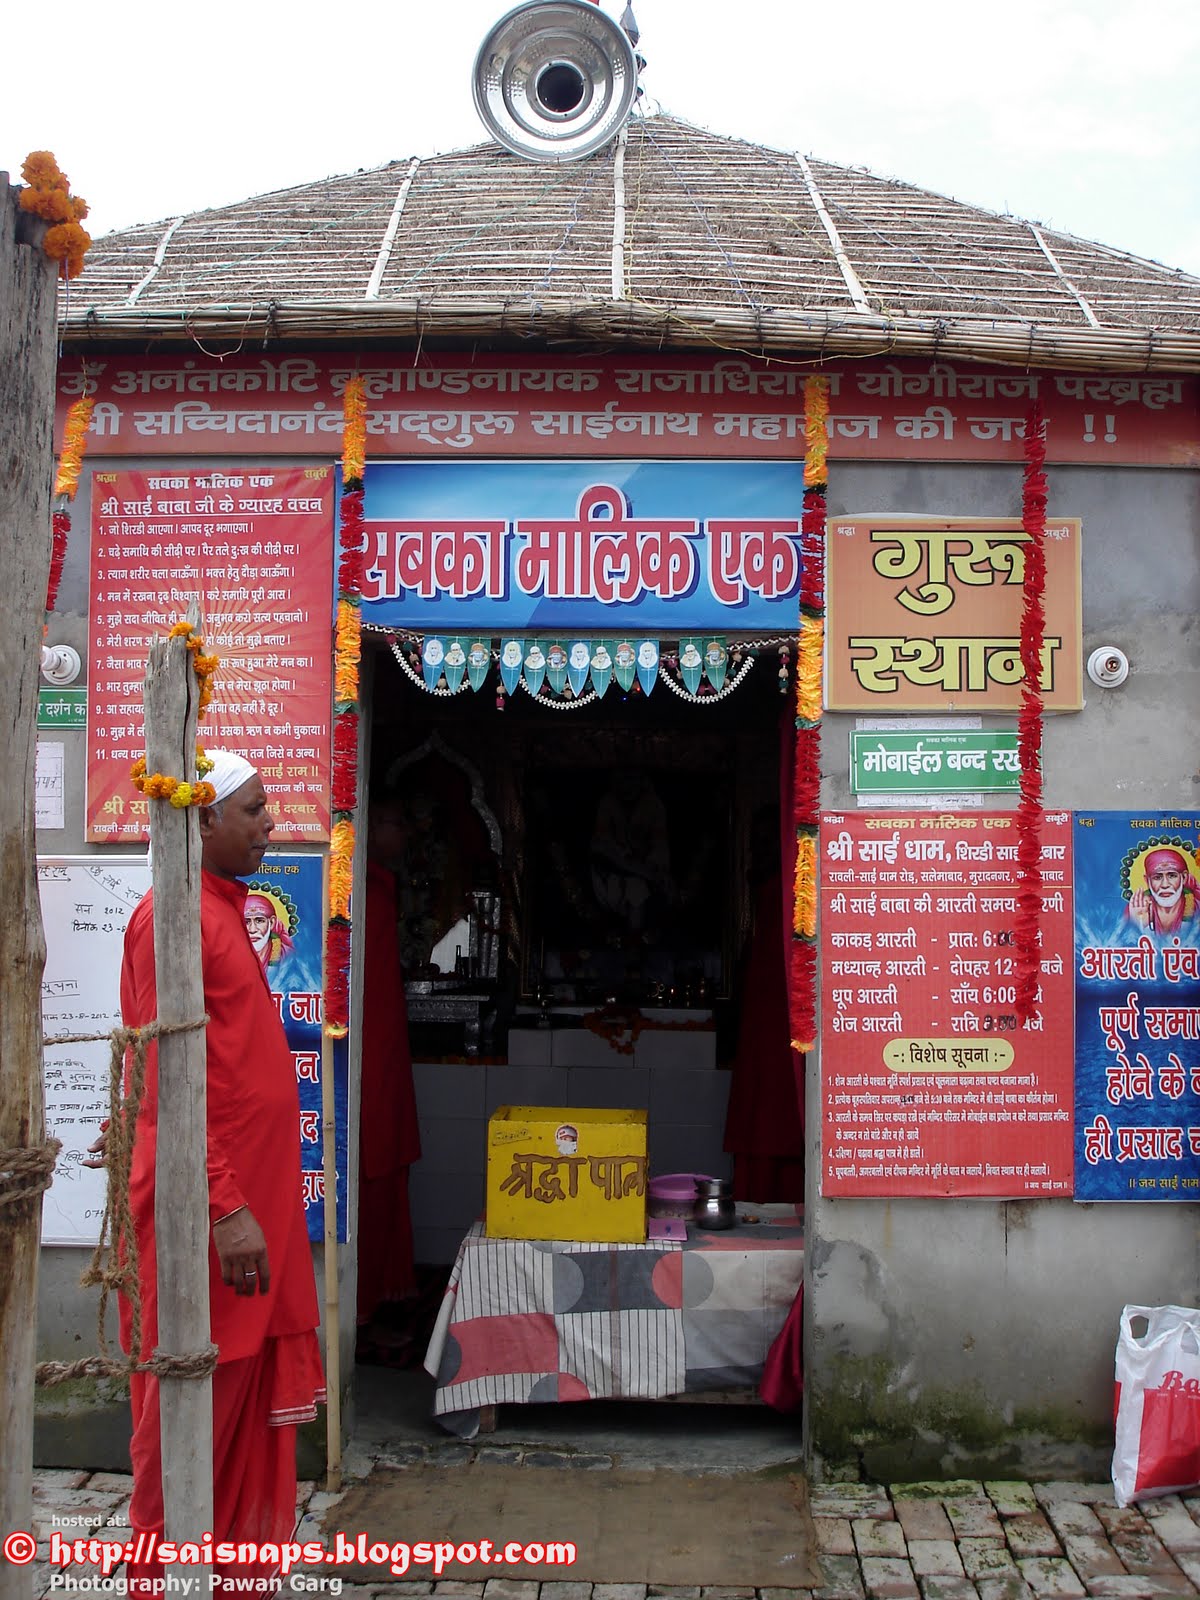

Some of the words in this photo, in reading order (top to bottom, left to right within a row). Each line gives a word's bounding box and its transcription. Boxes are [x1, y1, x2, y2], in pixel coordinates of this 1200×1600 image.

[111, 359, 321, 393] अनंतकोटि
[856, 364, 1040, 399] योगीराज
[894, 406, 957, 441] की
[148, 478, 190, 489] सबका
[248, 476, 274, 487] एक
[101, 497, 118, 514] श्री
[157, 501, 190, 513] बाबा
[195, 495, 214, 512] जी
[219, 494, 234, 512] के
[239, 499, 283, 512] ग्यारह
[288, 498, 322, 511] वचन
[109, 522, 119, 534] जो
[122, 522, 144, 534] शिरडी
[147, 525, 173, 535] आएगा
[180, 524, 202, 534] आपद
[204, 524, 214, 536] दूर
[216, 523, 248, 534] भगाएगा
[122, 544, 149, 556] समाधि
[151, 544, 162, 556] की
[185, 546, 195, 556] पर
[202, 542, 213, 556] पैर
[215, 542, 229, 555] तले
[251, 542, 262, 555] की
[284, 545, 294, 554] पर
[361, 518, 510, 601] सबका
[513, 483, 700, 603] मालिक
[703, 518, 802, 605] एक
[108, 592, 121, 601] मन
[133, 592, 156, 601] रखना
[222, 588, 249, 600] समाधि
[251, 588, 264, 603] पूरी
[267, 590, 285, 599] आस
[848, 636, 1062, 693] स्थान
[46, 698, 71, 717] दर्शन
[862, 742, 943, 775] मोबाईल
[946, 750, 987, 771] बन्द
[287, 767, 307, 776] राम
[293, 782, 304, 792] की
[307, 784, 322, 792] जय
[103, 797, 125, 815] श्री
[284, 804, 317, 814] दरबार
[865, 816, 916, 830] सबका
[920, 815, 978, 829] मालिक
[982, 818, 1012, 829] एक
[827, 832, 854, 860] श्री
[904, 840, 951, 862] धाम,
[955, 841, 993, 861] शिरडी
[284, 865, 300, 875] एक
[880, 872, 897, 882] धाम
[830, 893, 846, 913] श्री
[880, 898, 910, 913] बाबा
[914, 892, 932, 913] की
[936, 892, 976, 912] आरती
[876, 927, 916, 947] आरती
[886, 955, 926, 976] आरती
[950, 954, 990, 977] दोपहर
[1040, 954, 1063, 974] बजे
[1080, 936, 1156, 980] आरती
[833, 990, 853, 1009] धूप
[857, 984, 898, 1004] आरती
[833, 1011, 857, 1032] शेज
[862, 1012, 902, 1032] आरती
[951, 1011, 979, 1032] रात्रि
[1100, 991, 1140, 1052] पूर्ण
[1144, 1007, 1200, 1040] समा
[910, 1042, 947, 1063] विशेष
[951, 1048, 989, 1068] सूचना
[1106, 1052, 1155, 1106] होने
[1159, 1053, 1185, 1100] के
[1085, 1114, 1112, 1165] ही
[1117, 1127, 1183, 1163] प्रसाद
[499, 1153, 587, 1203] श्रद्धा
[1139, 1178, 1156, 1188] जय
